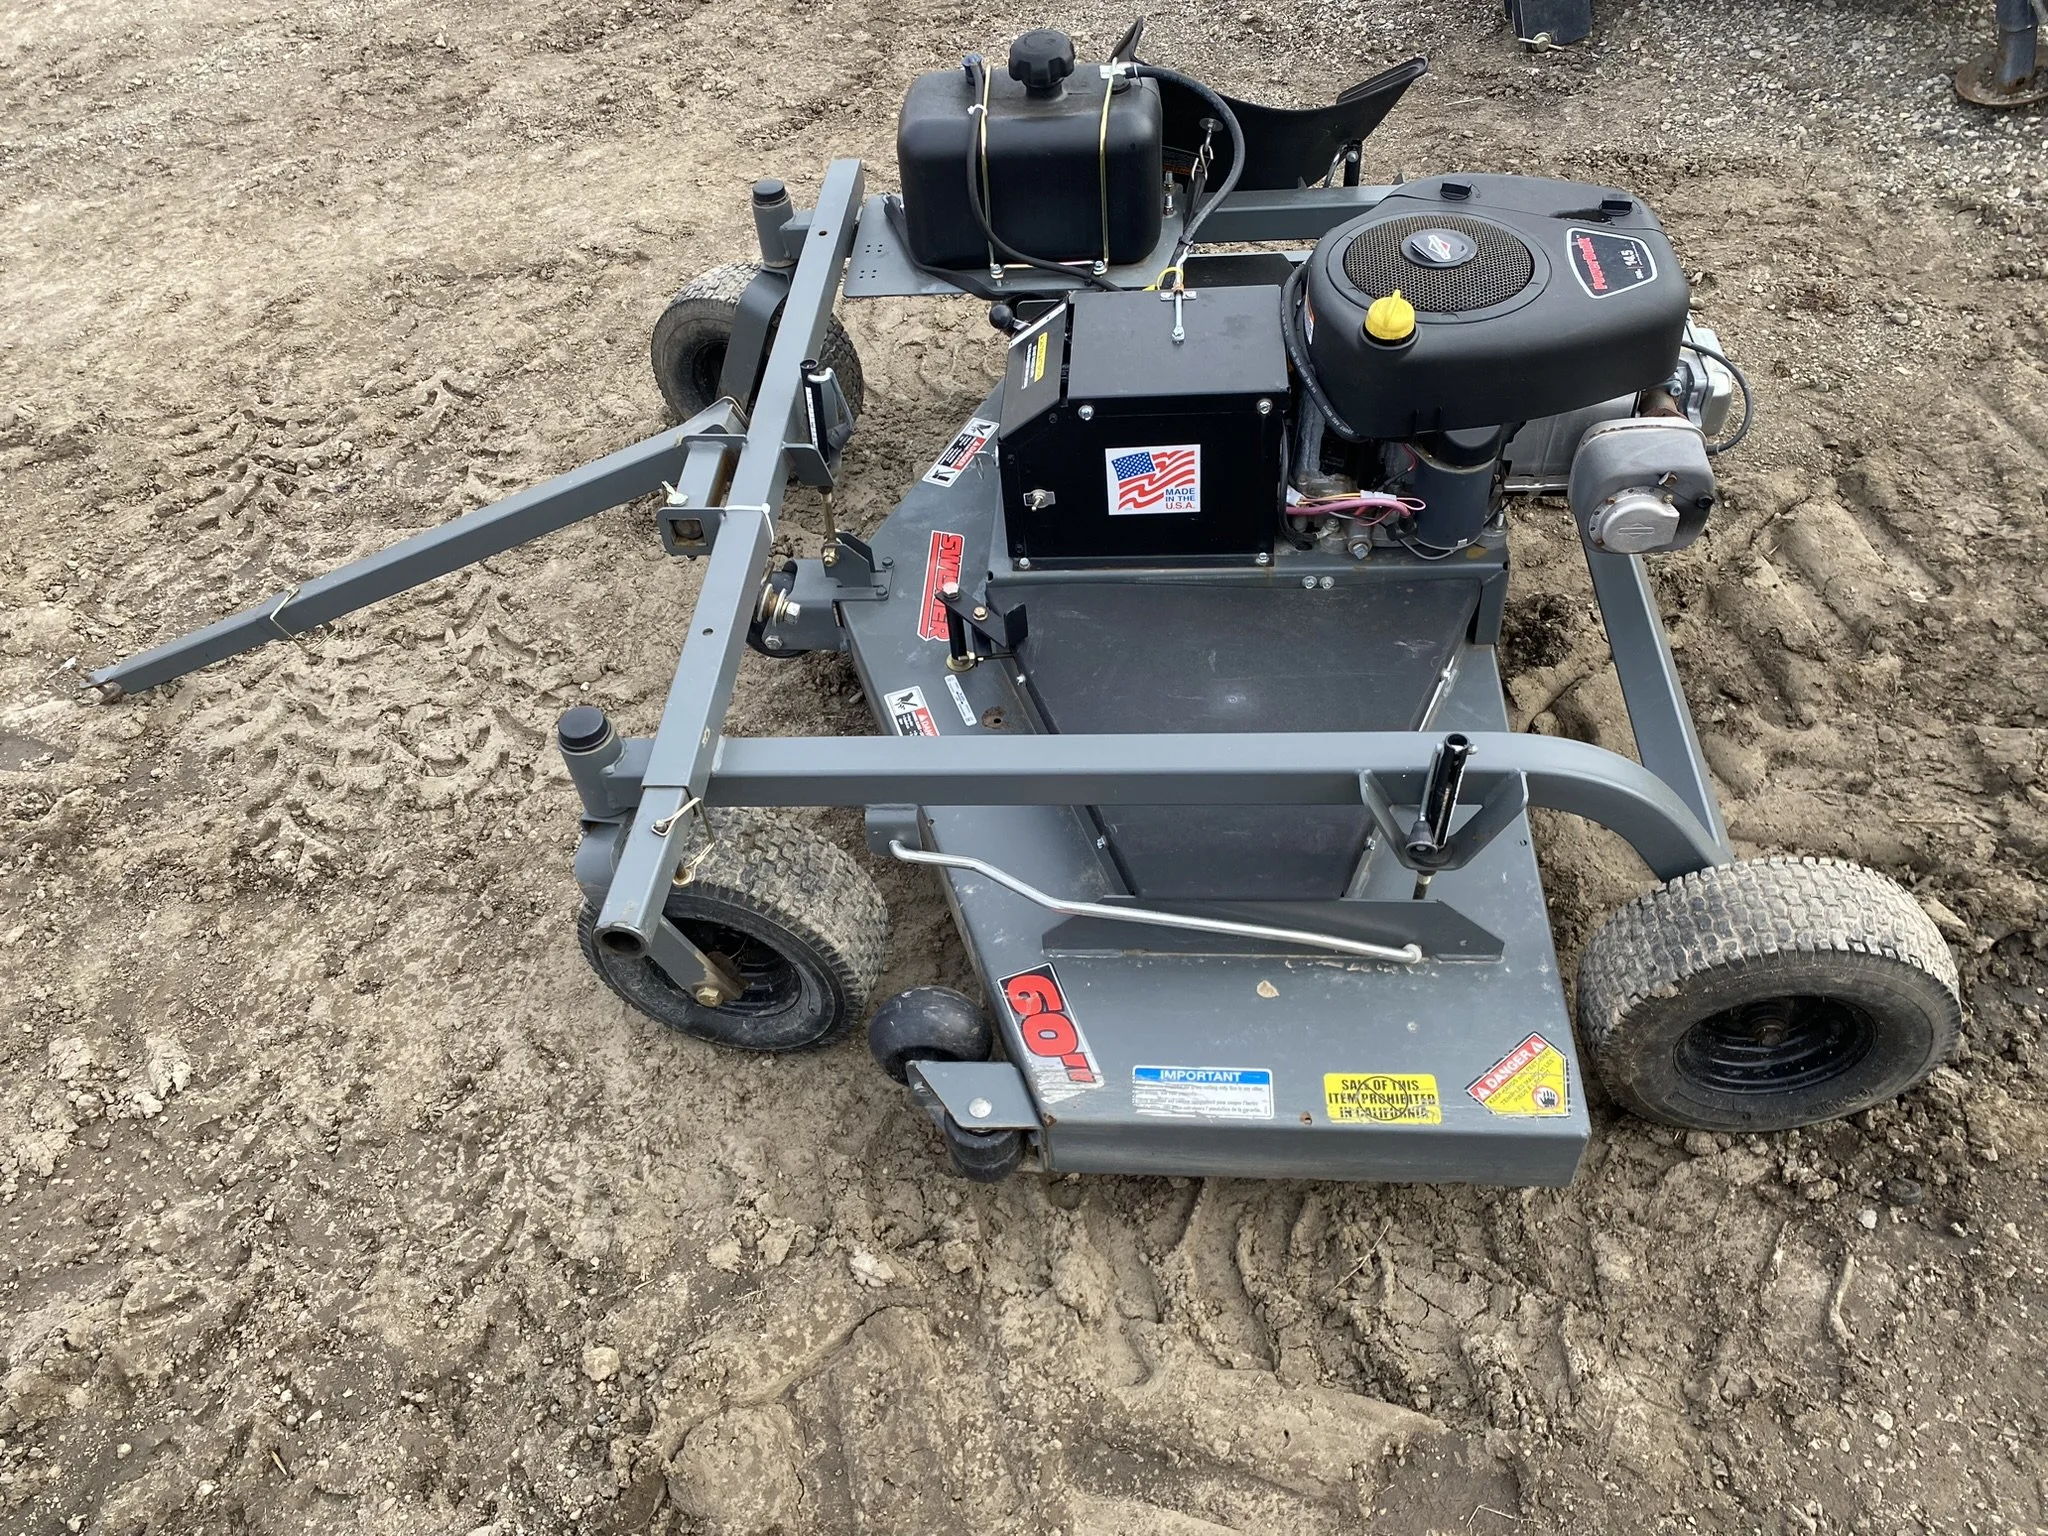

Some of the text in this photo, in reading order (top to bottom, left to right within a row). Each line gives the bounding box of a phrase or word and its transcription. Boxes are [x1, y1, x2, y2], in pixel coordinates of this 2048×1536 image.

[1165, 488, 1195, 496] MADE
[1165, 502, 1195, 510] U.S.A.
[929, 533, 963, 640] SWISER
[1488, 1049, 1532, 1088] DANGER
[1160, 1070, 1242, 1082] IMPORTANT
[1373, 1080, 1387, 1091] OF
[1392, 1080, 1419, 1091] THIS
[1328, 1093, 1435, 1105] ITEM PROHIBITED
[1339, 1107, 1429, 1118] IN CALIFORNIA
